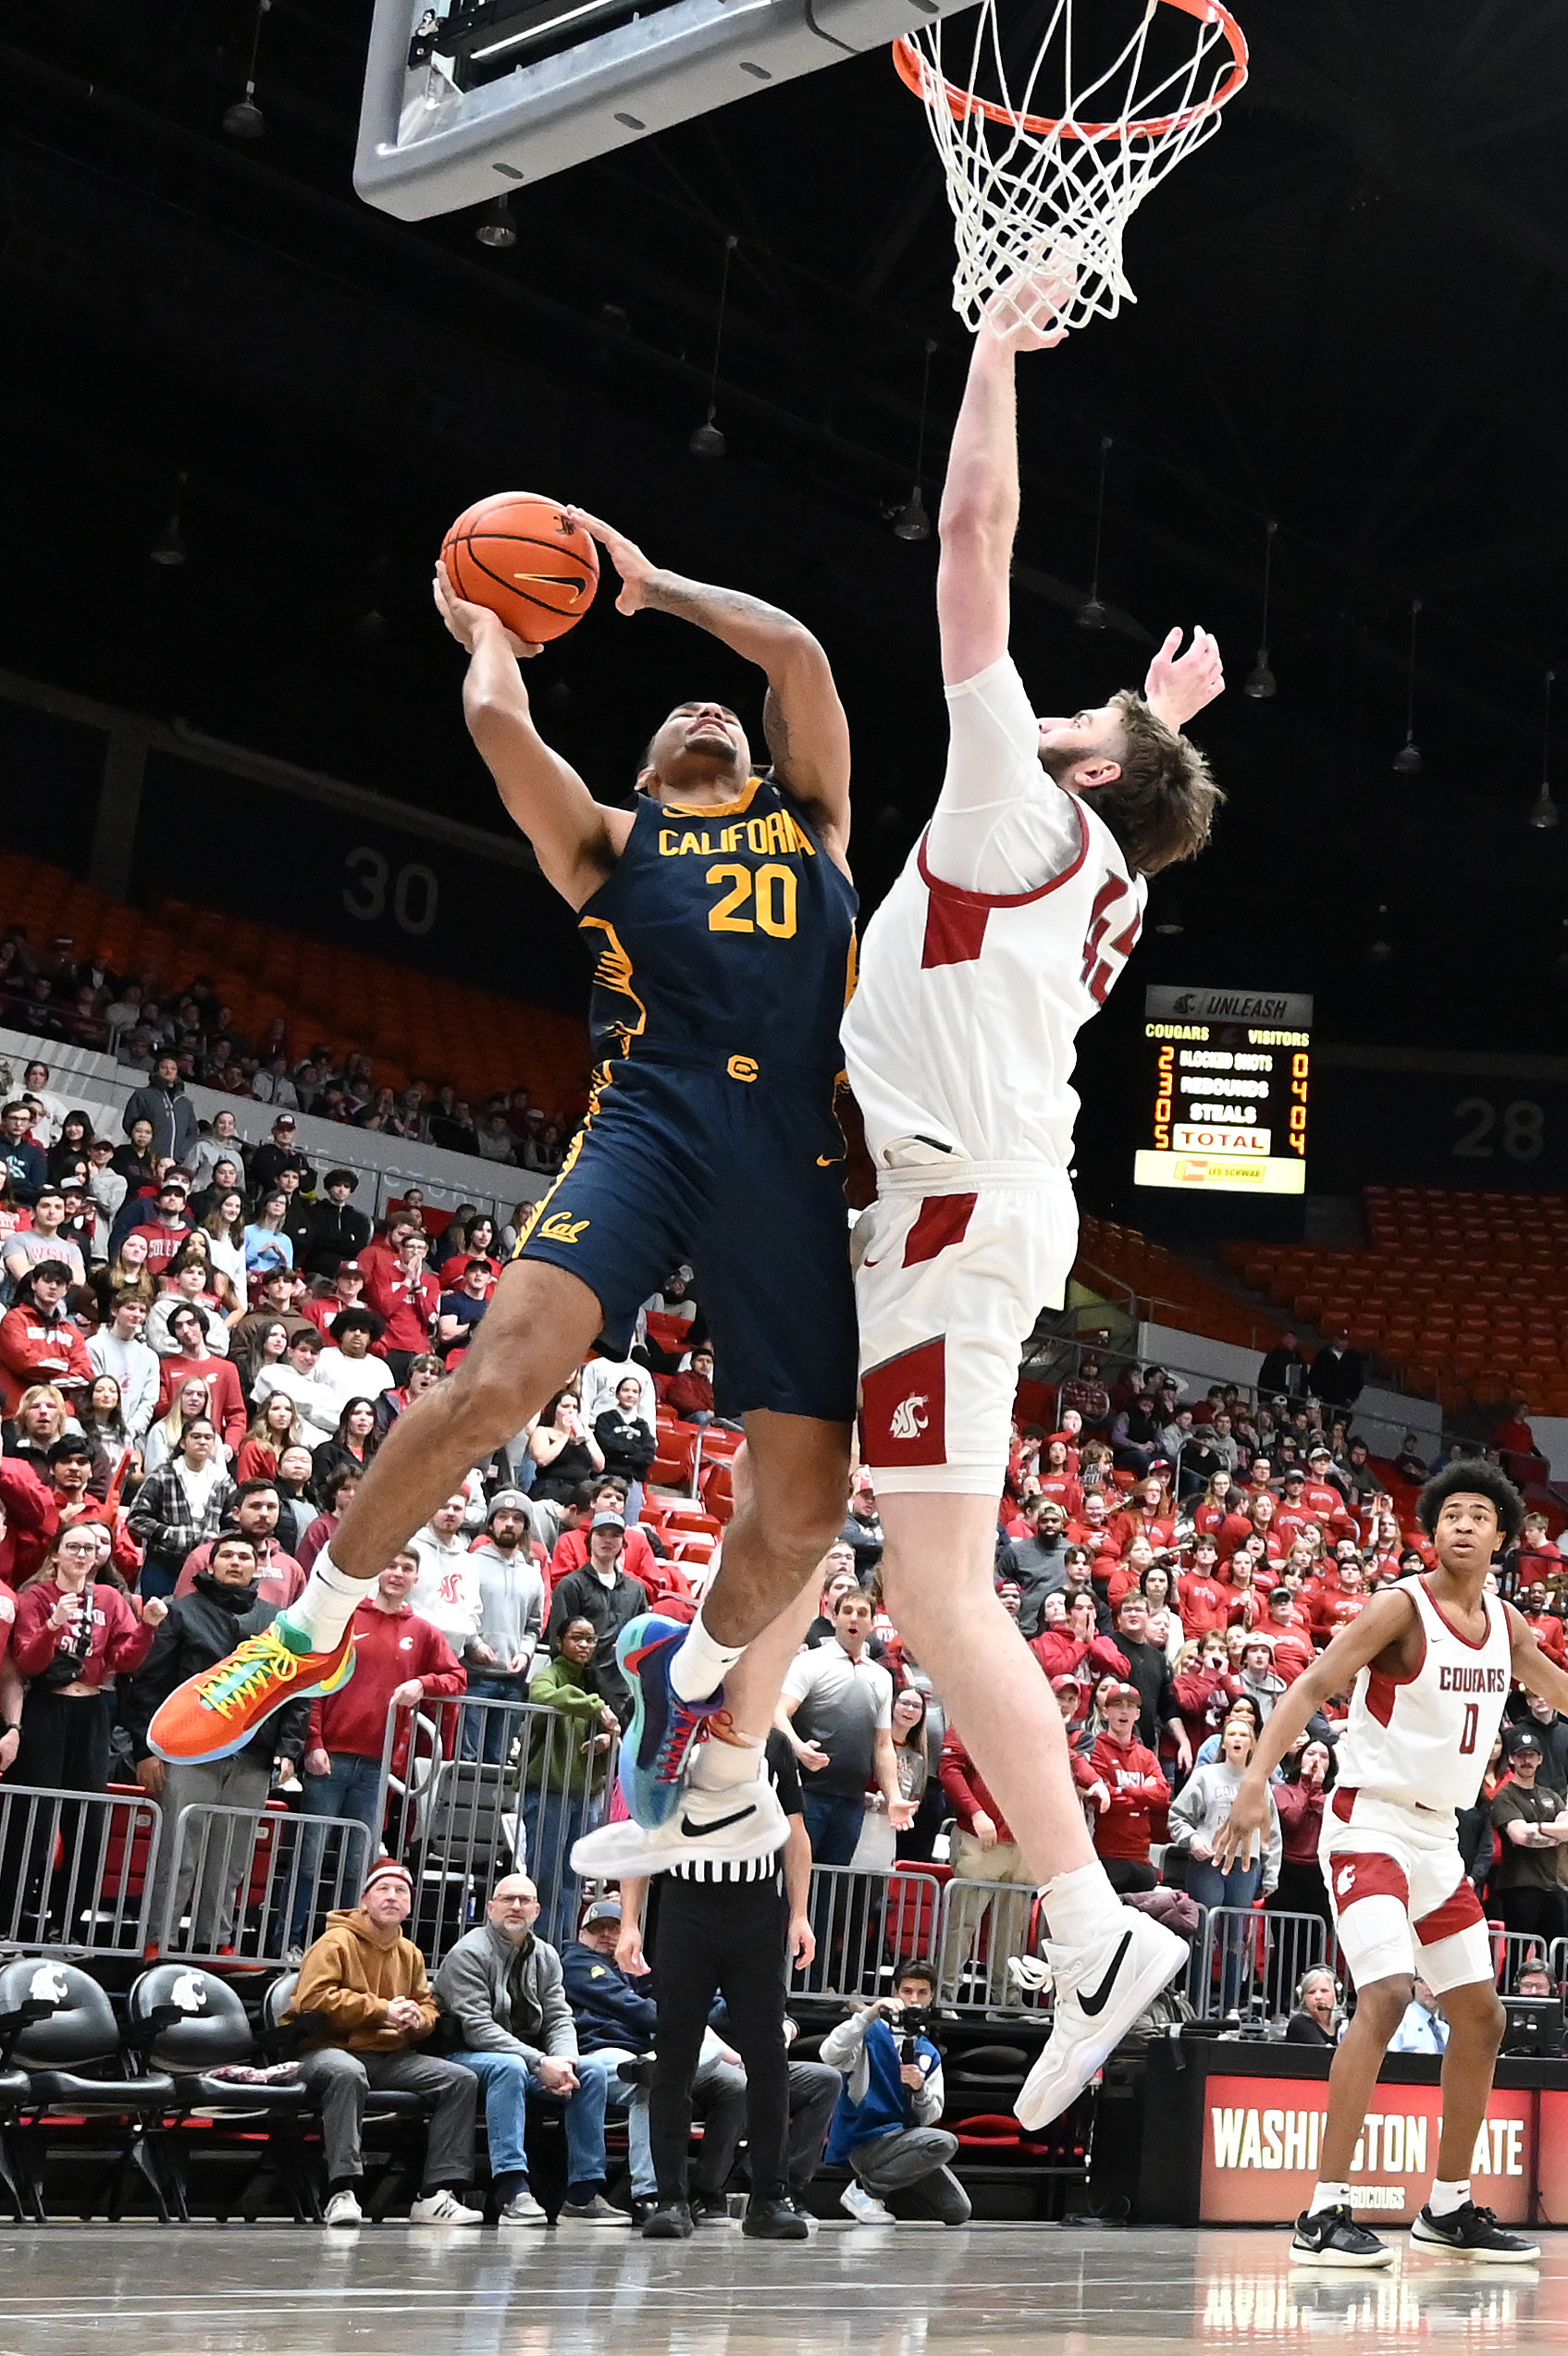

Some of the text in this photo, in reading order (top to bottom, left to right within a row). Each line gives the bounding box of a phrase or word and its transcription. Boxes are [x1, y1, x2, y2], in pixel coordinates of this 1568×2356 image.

[659, 808, 817, 857] CALIFORNA
[343, 846, 438, 935] 30
[706, 863, 797, 940] 20
[1206, 995, 1289, 1018] UNLEASH
[1145, 1023, 1210, 1042] COUGARS
[1248, 1029, 1310, 1047] VISITORS
[1158, 1045, 1309, 1079] 2 BLOCKED SHOTS 0
[1158, 1071, 1308, 1104] 3 REBOUNDS 4
[1154, 1098, 1306, 1130] 0 STEALS 0
[1451, 1097, 1545, 1161] 28
[1154, 1124, 1305, 1156] 5 TOTAL 4
[537, 1211, 591, 1244] Cal
[1459, 1702, 1479, 1755] 0
[1211, 2107, 1525, 2176] WASHITON ATE
